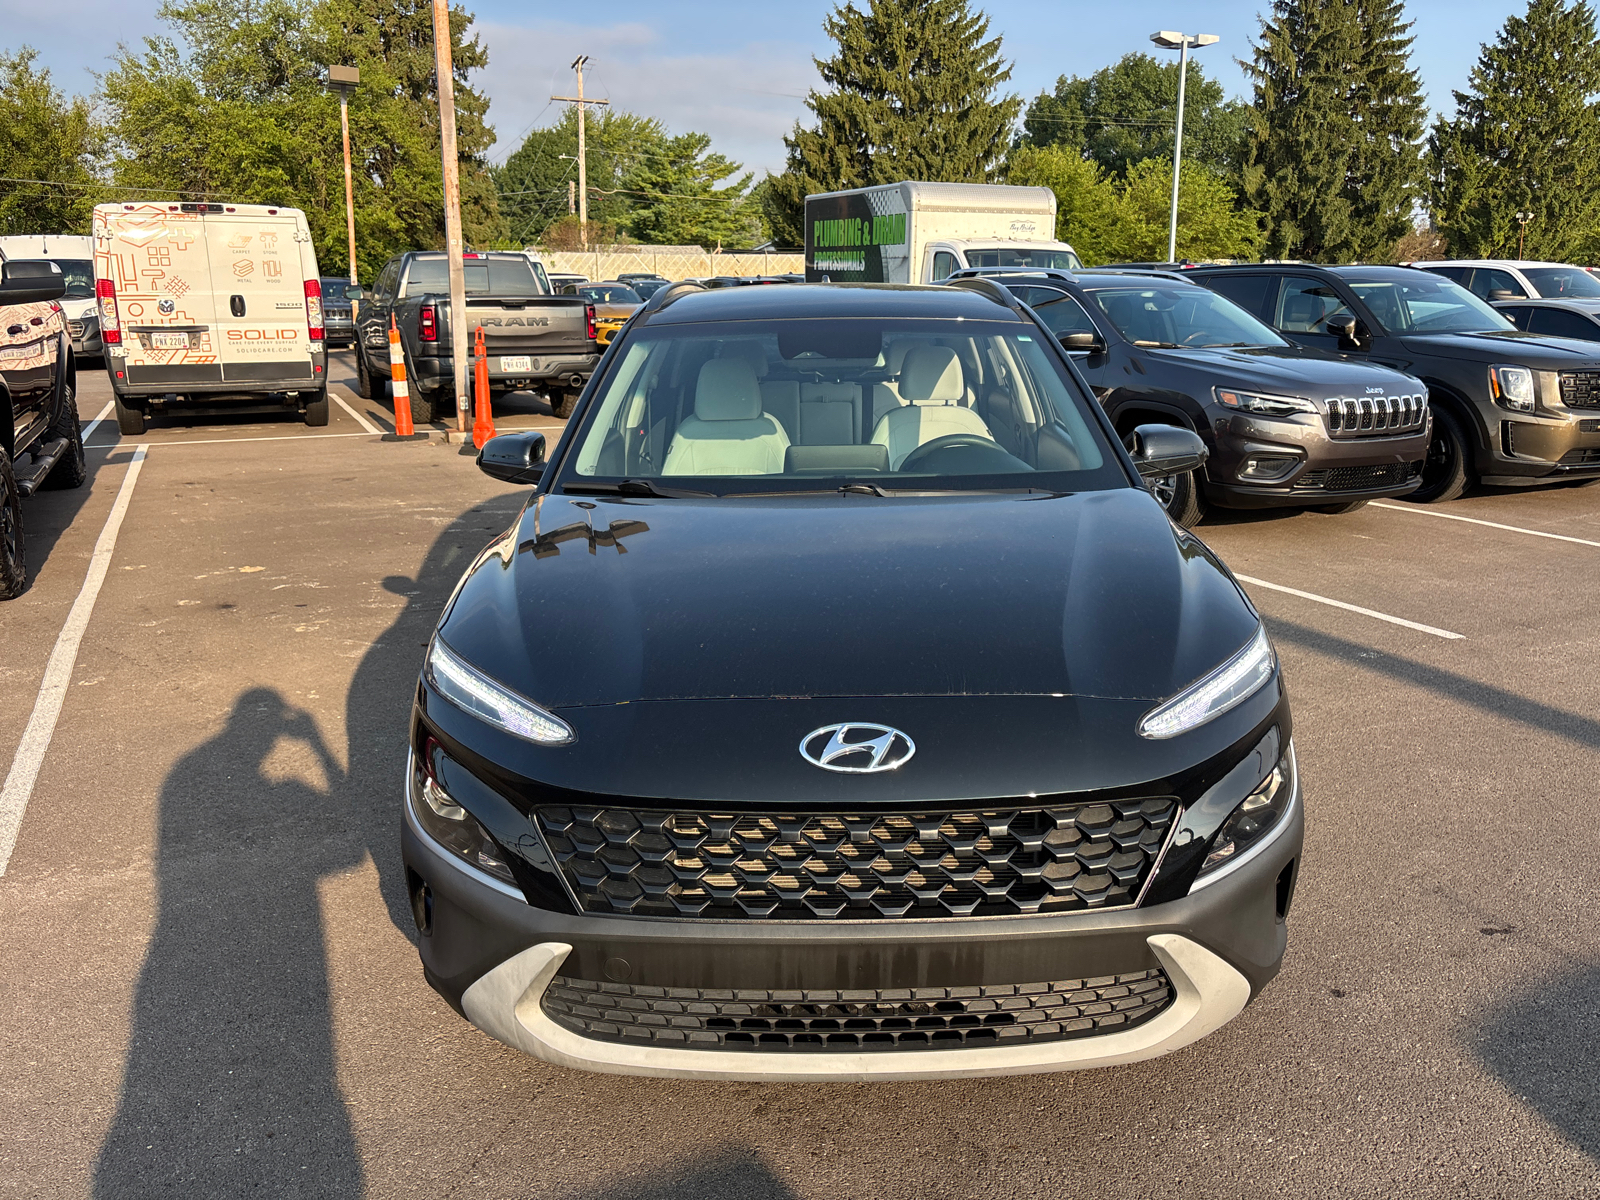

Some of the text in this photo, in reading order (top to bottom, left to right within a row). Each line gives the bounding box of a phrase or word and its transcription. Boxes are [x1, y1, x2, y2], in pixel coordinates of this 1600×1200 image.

[814, 213, 906, 247] PLUMBING & DRAIN
[814, 251, 865, 272] PROFESSIONALS
[480, 317, 549, 327] RAM
[226, 329, 298, 340] SOLID
[154, 337, 186, 346] PNX 2204
[1365, 386, 1385, 395] Jeep
